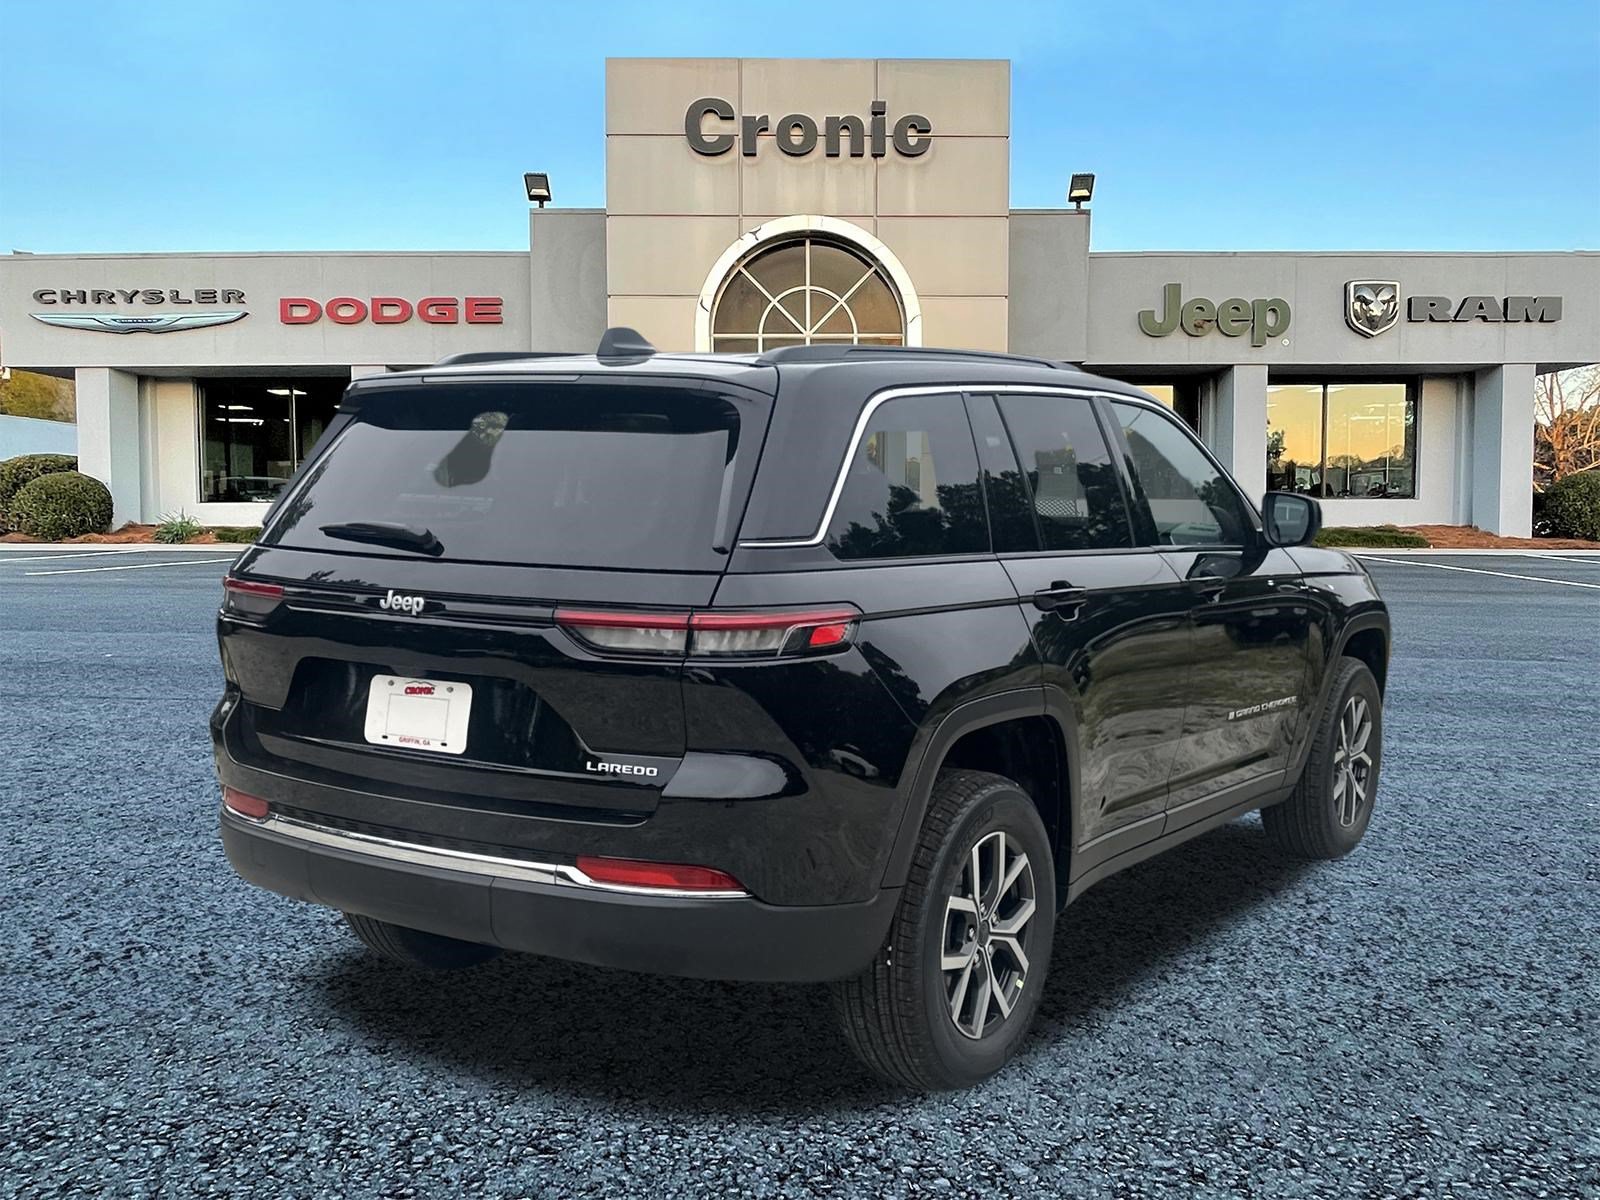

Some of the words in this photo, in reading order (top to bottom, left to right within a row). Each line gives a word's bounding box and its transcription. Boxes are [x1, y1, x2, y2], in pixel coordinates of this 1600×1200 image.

[684, 97, 932, 157] Cronic
[32, 289, 246, 305] CHRYSLER
[279, 297, 504, 325] DODGE
[1407, 295, 1562, 323] RAM
[1138, 283, 1291, 347] Jeep
[379, 589, 424, 615] Jeep
[586, 761, 658, 776] LAREDO
